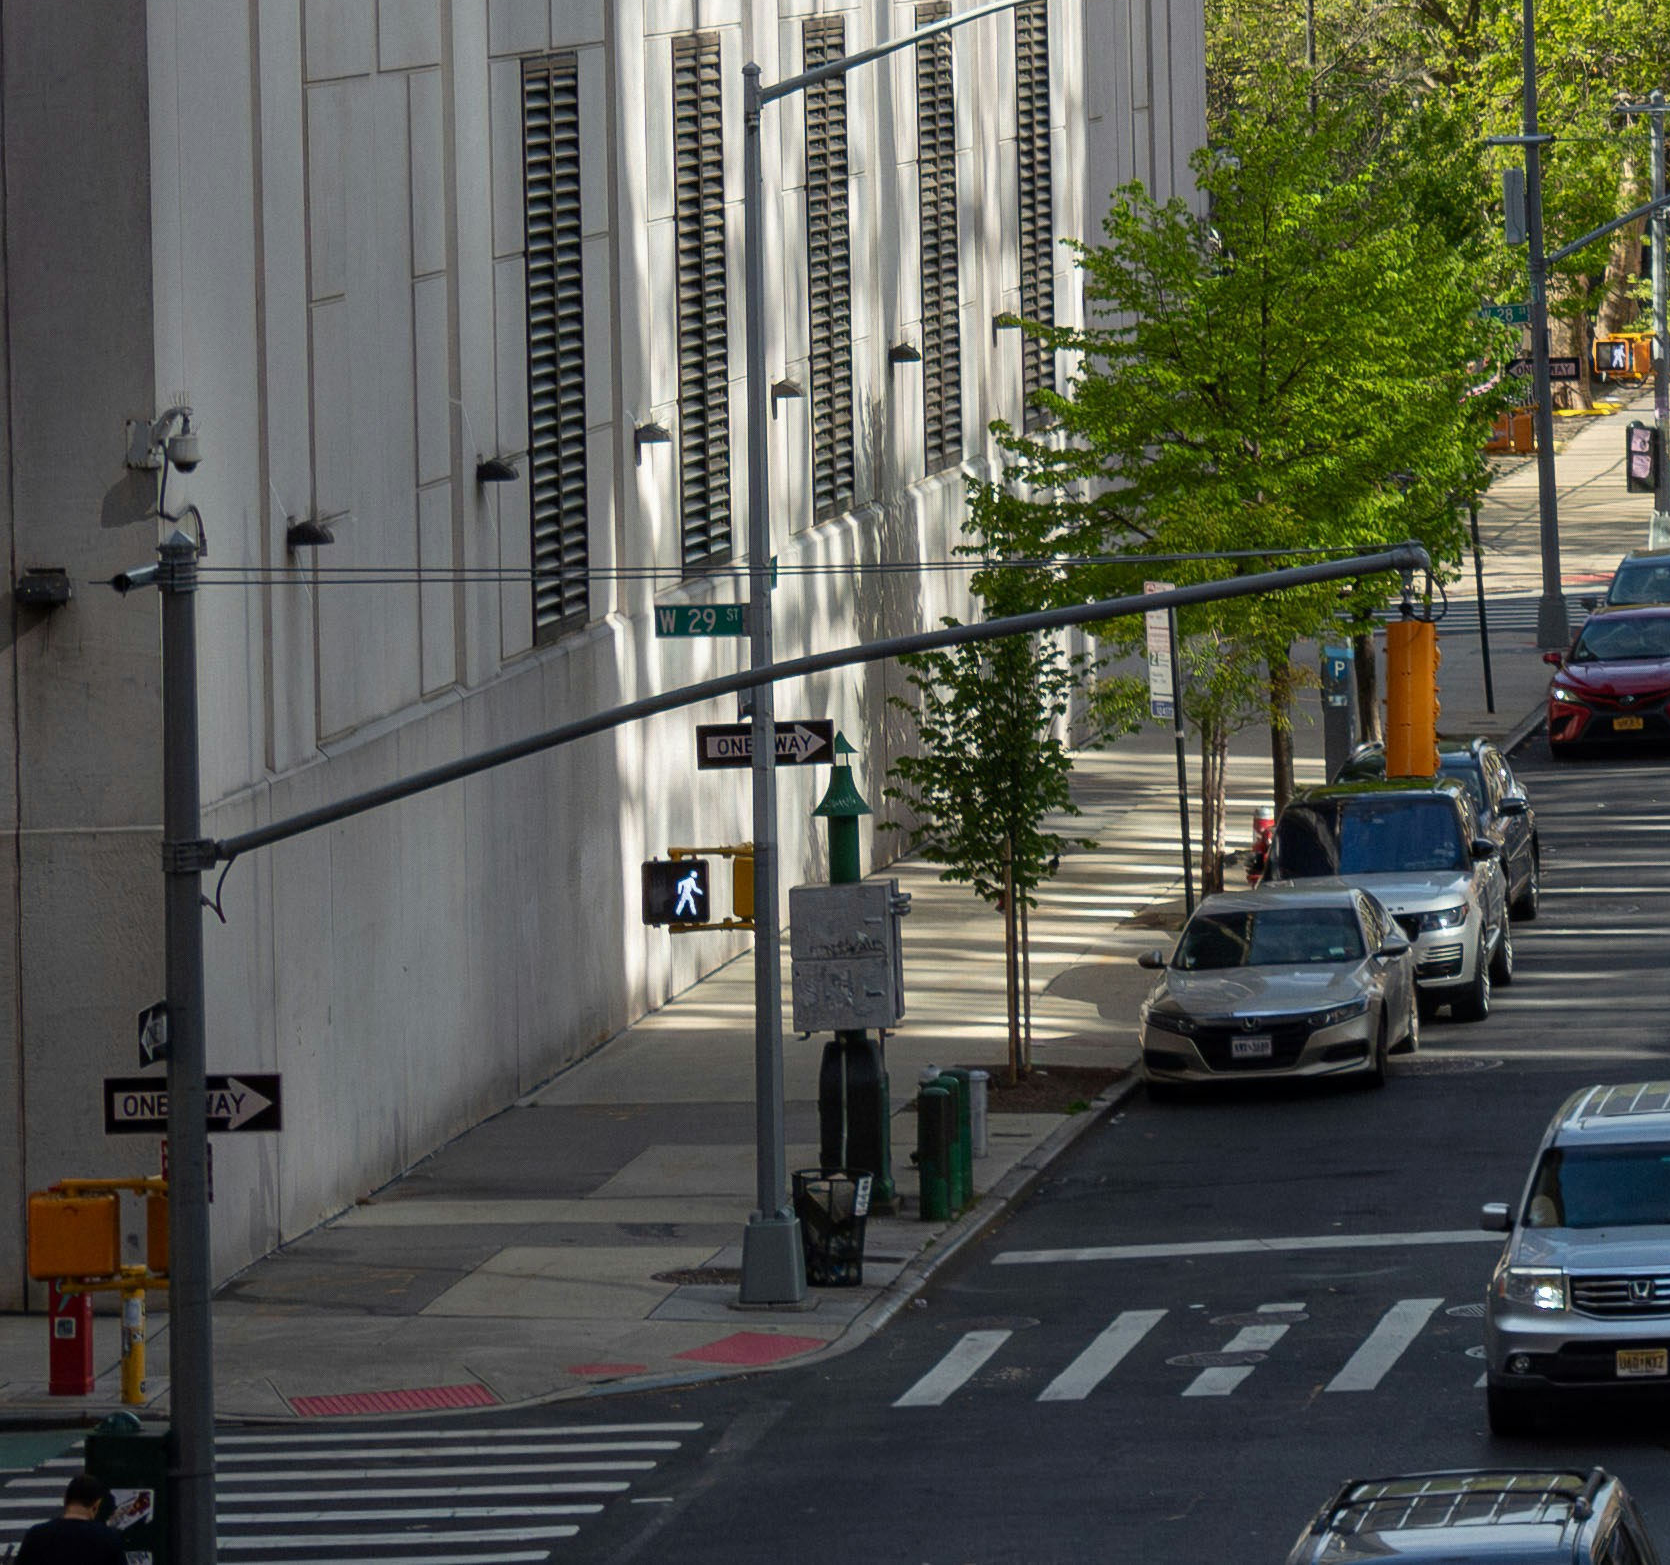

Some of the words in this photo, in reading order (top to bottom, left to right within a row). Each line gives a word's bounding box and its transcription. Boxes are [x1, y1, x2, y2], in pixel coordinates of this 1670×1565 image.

[1497, 307, 1513, 322] 28
[659, 609, 676, 633] W
[687, 608, 716, 633] 29
[726, 608, 739, 622] ST
[1335, 660, 1345, 677] P
[717, 737, 752, 756] ONE
[123, 1095, 168, 1117] ONE
